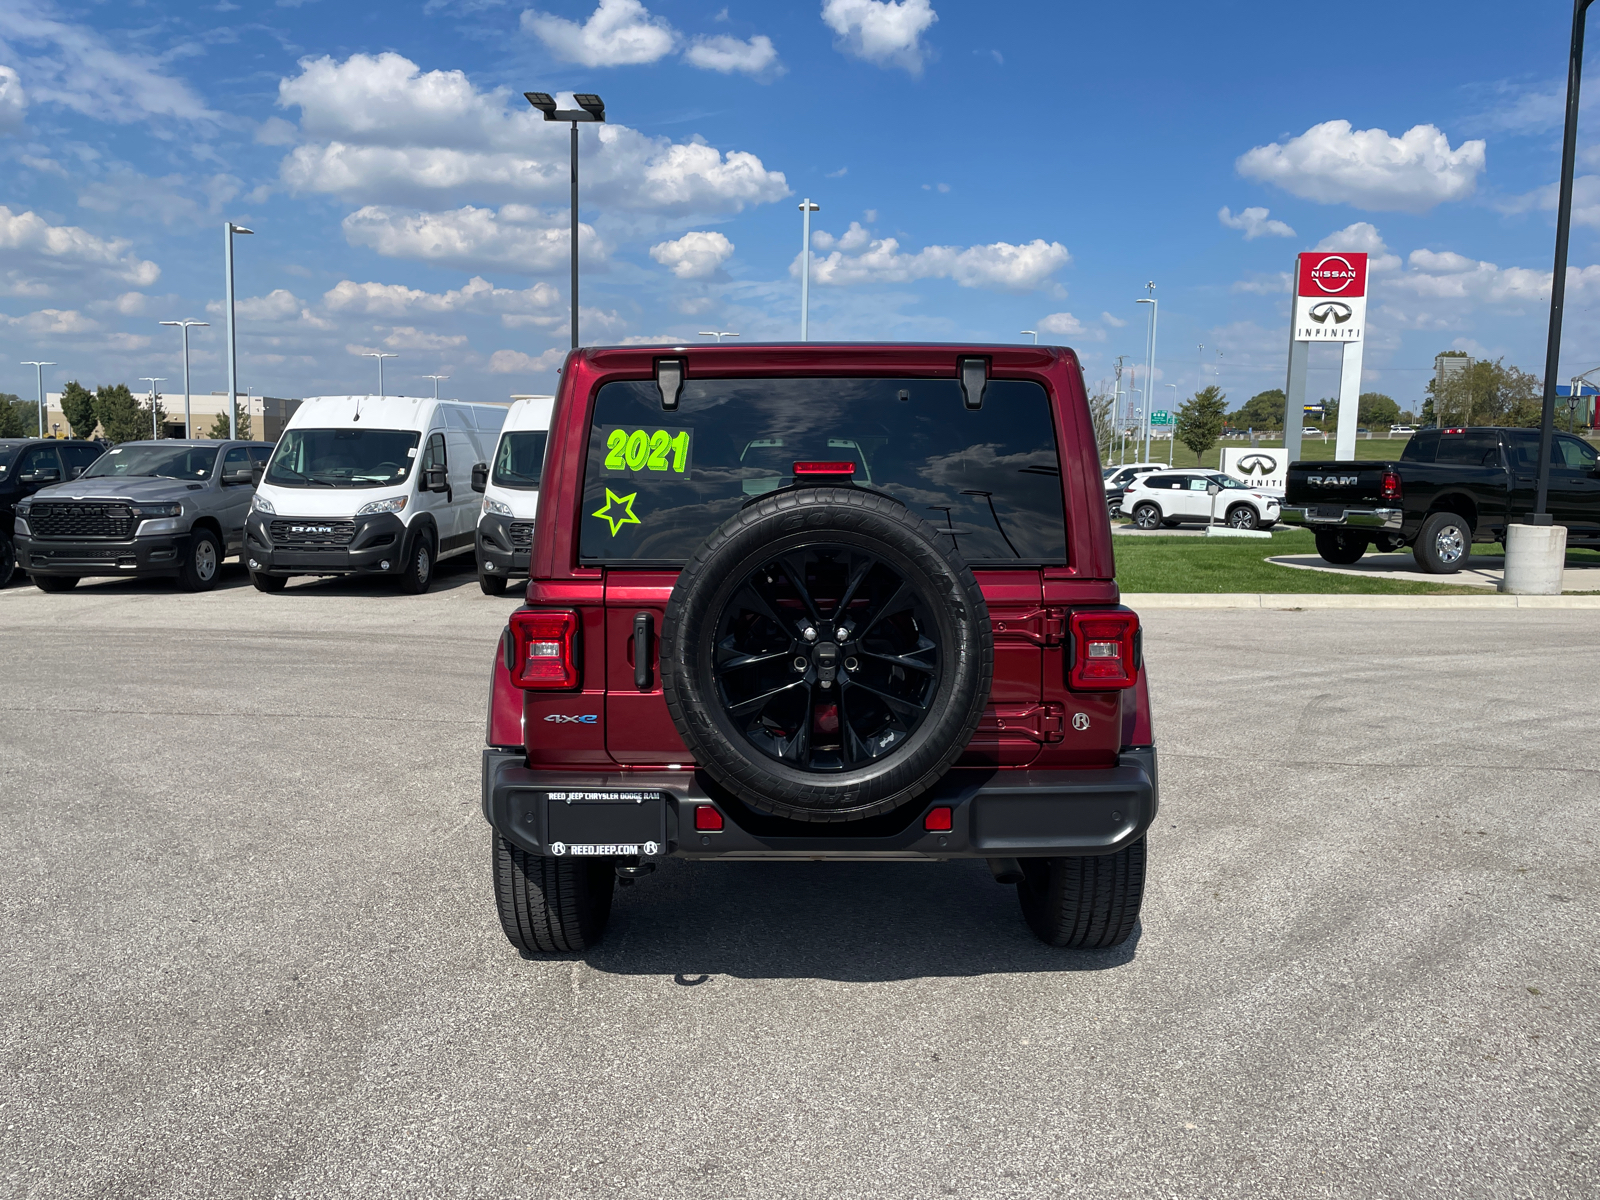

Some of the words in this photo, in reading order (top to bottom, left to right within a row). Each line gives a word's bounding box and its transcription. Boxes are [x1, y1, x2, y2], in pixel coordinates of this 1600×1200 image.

[1298, 328, 1360, 337] INFINITI
[604, 429, 690, 473] 2021
[1307, 476, 1358, 485] RAM
[52, 507, 102, 515] RAM
[548, 792, 566, 800] REED
[567, 792, 584, 800] JEEP
[584, 792, 619, 800] CHRYSLER
[620, 792, 643, 800] DODGE
[643, 792, 660, 800] RAM
[570, 845, 638, 855] REEDJEEP.COM
